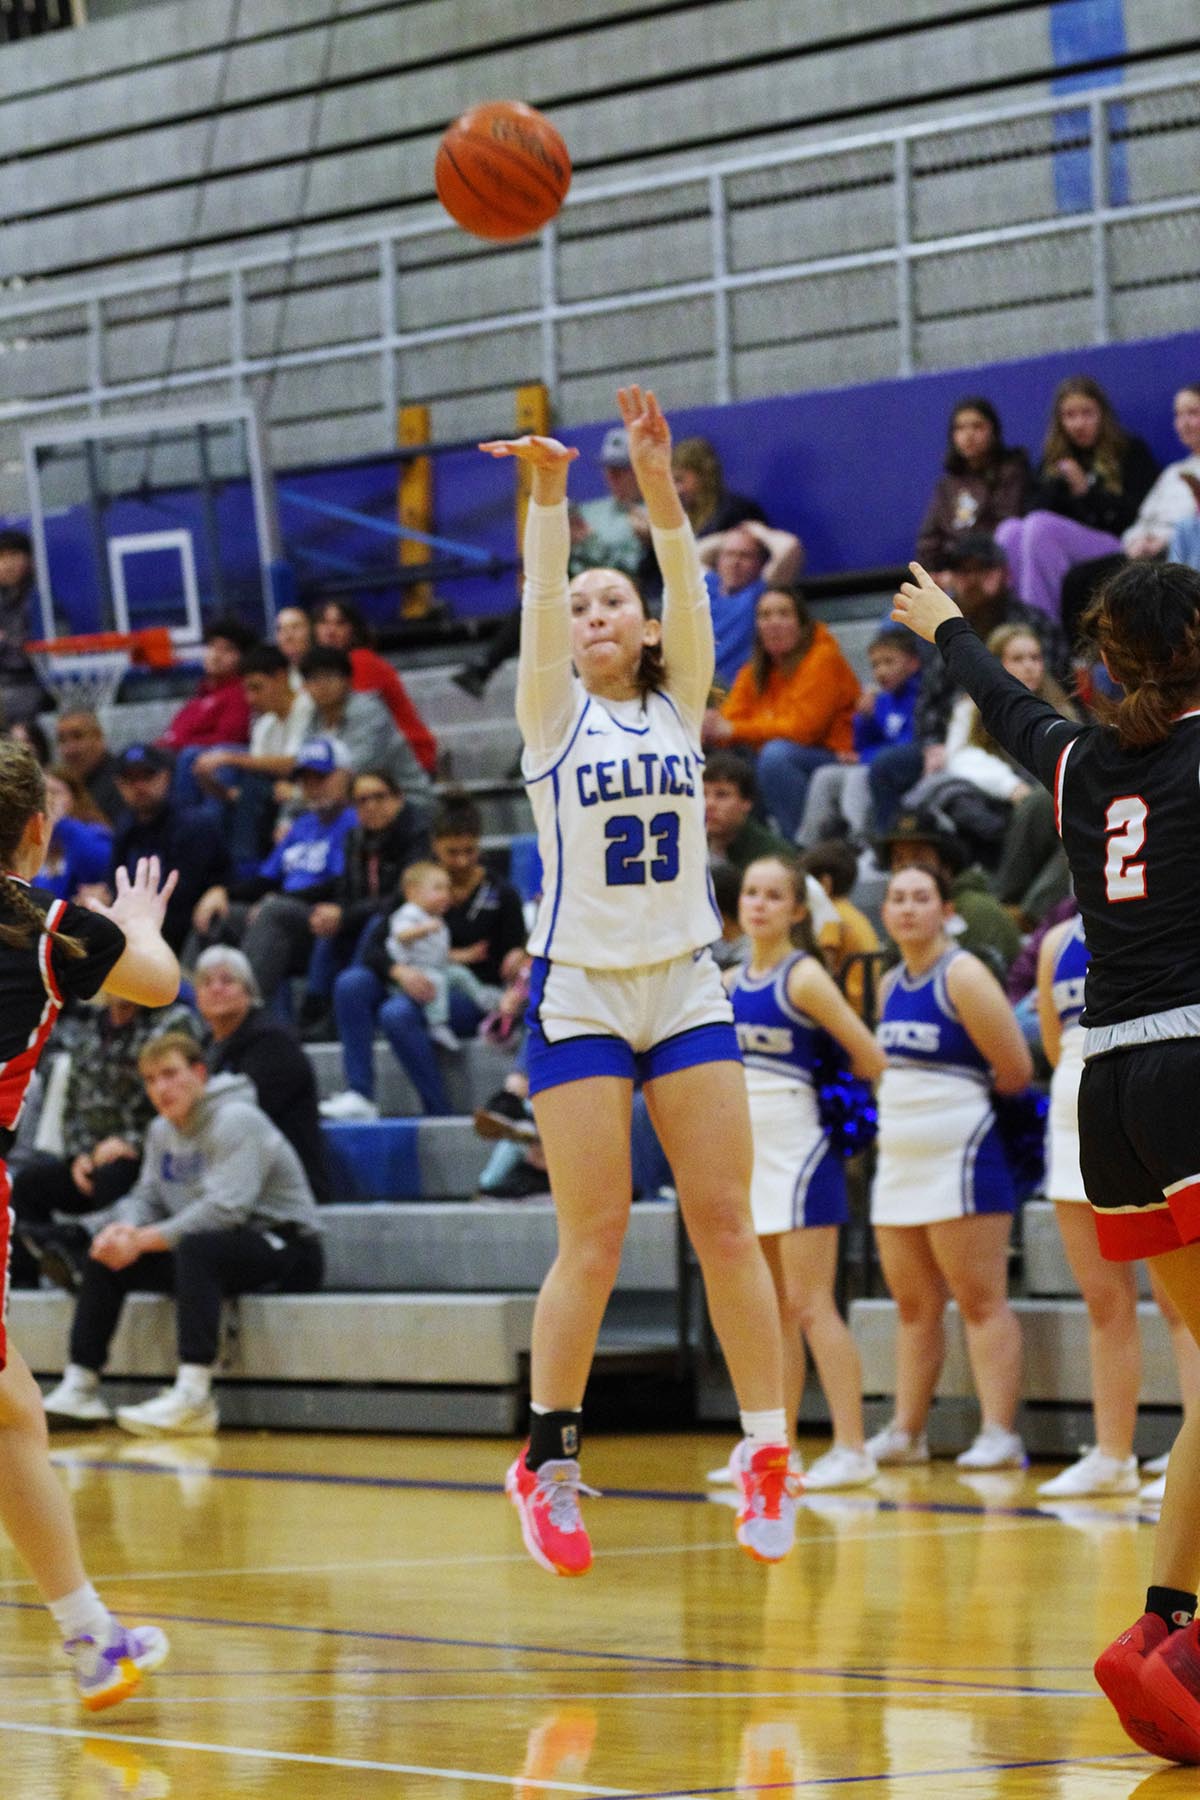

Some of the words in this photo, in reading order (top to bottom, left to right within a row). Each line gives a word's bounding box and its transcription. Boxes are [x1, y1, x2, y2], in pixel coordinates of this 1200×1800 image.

[576, 753, 695, 808] CELTICS
[604, 811, 680, 886] 23
[1104, 794, 1150, 904] 2
